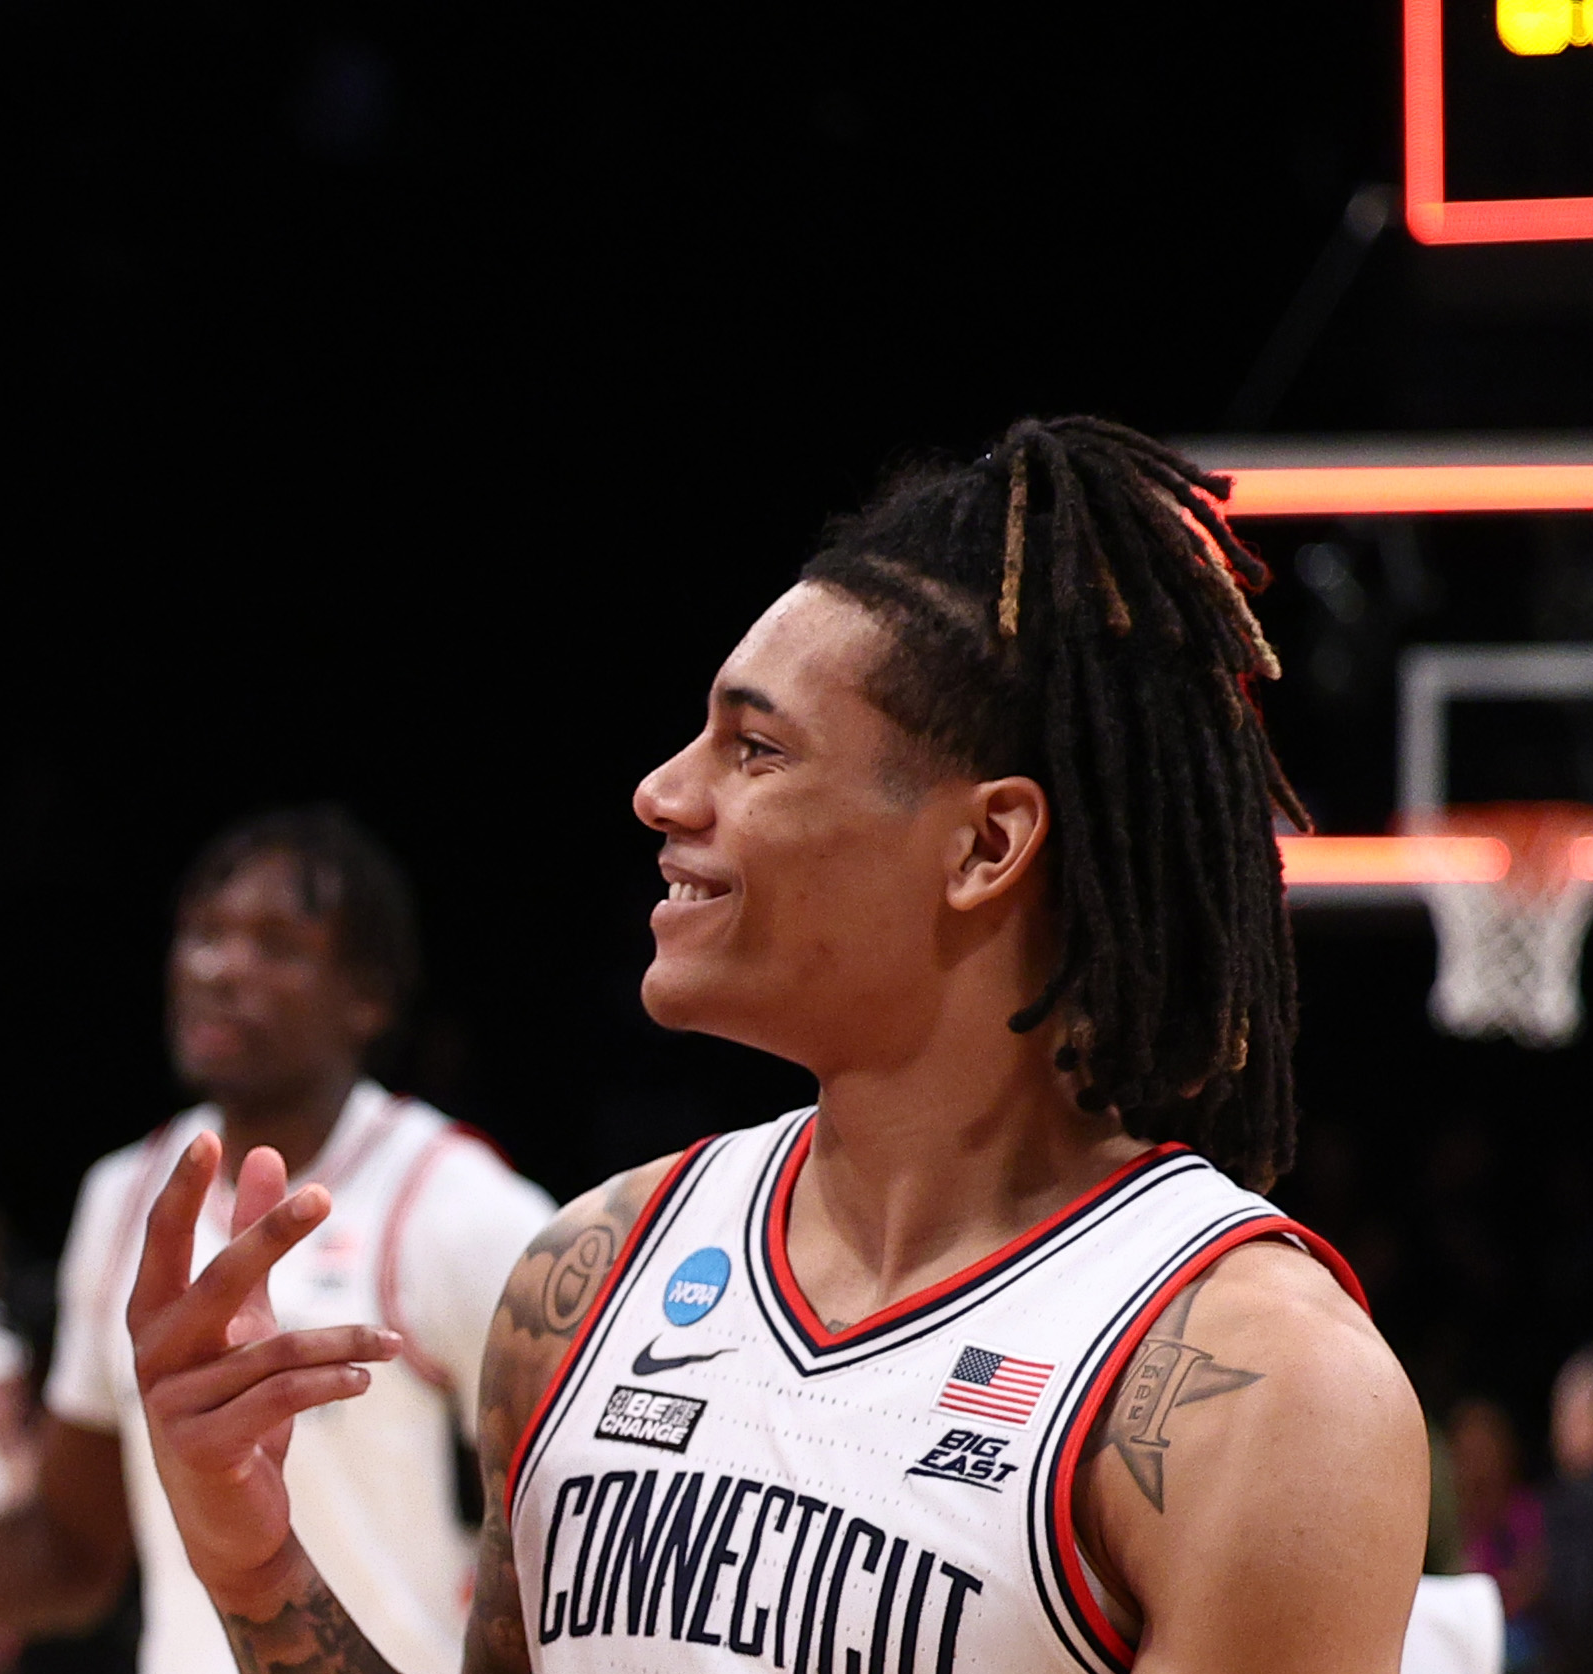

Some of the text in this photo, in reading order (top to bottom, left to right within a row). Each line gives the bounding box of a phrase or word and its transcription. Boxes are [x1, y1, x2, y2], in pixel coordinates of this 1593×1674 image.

[668, 1280, 719, 1307] NCAA
[599, 1414, 689, 1444] CHANGE
[936, 1428, 1010, 1458] BIG
[918, 1448, 1019, 1482] EAST
